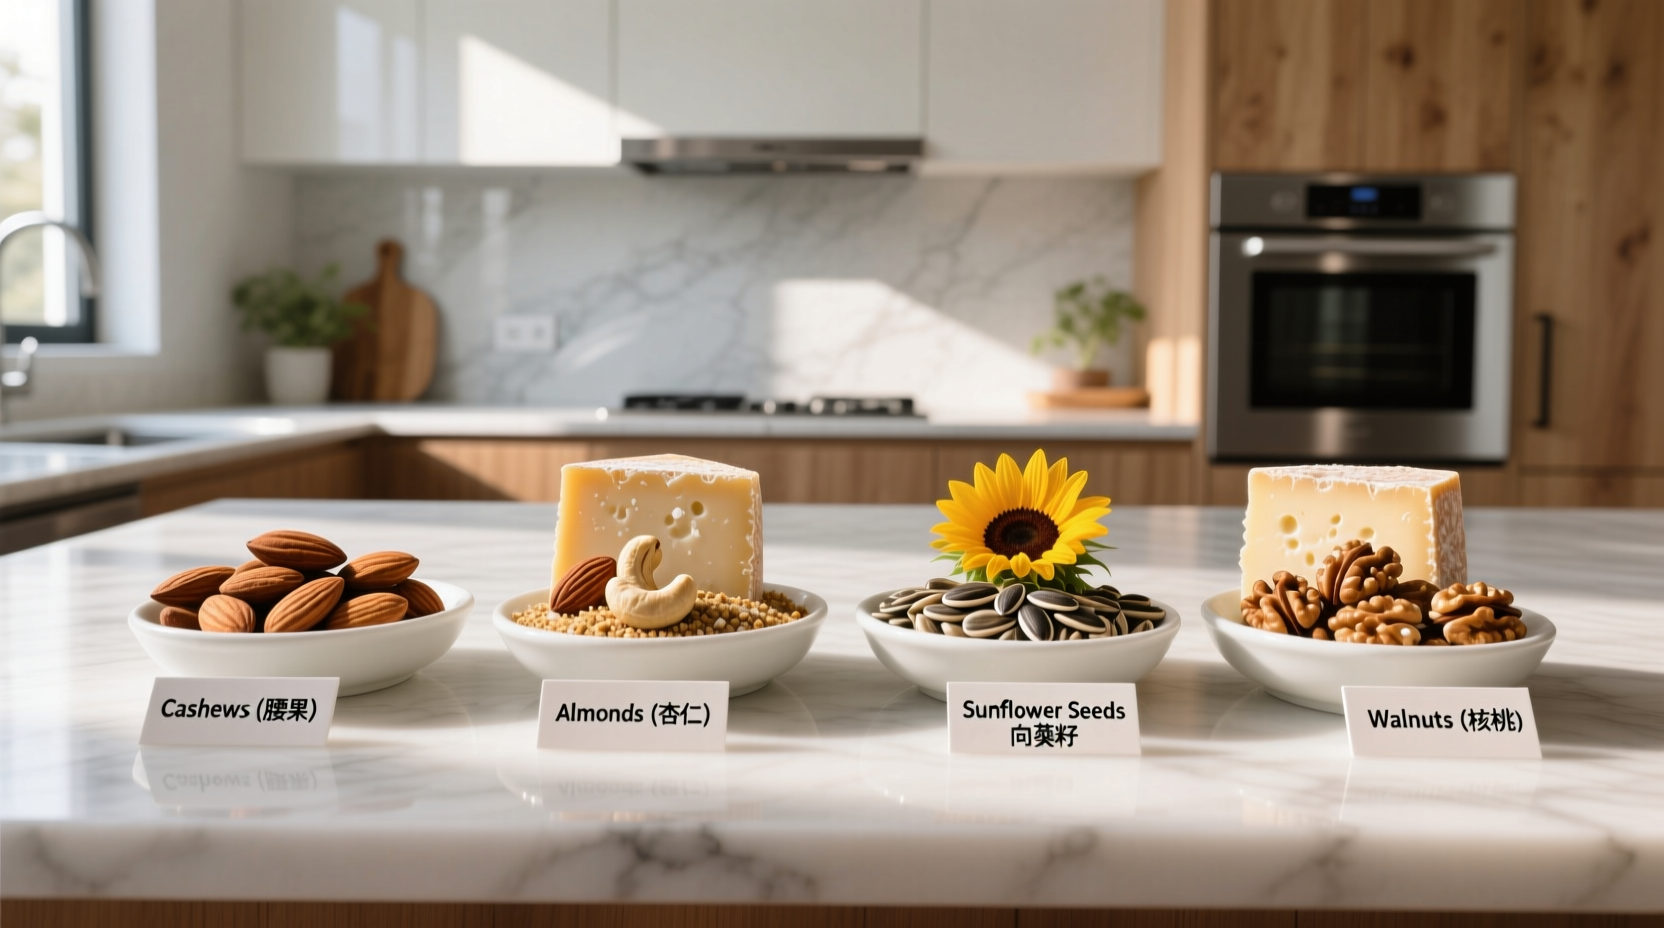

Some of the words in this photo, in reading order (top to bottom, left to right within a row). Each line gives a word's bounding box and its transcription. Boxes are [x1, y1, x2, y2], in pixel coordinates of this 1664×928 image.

[161, 698, 250, 718] Cashews
[256, 697, 317, 723] (腰果)
[555, 702, 644, 722] Almonds
[651, 702, 711, 728] (杏仁)
[963, 699, 1062, 719] Sunflower
[1068, 701, 1126, 720] Seeds
[1367, 708, 1454, 729] Walnuts
[1461, 708, 1523, 733] (核桃)
